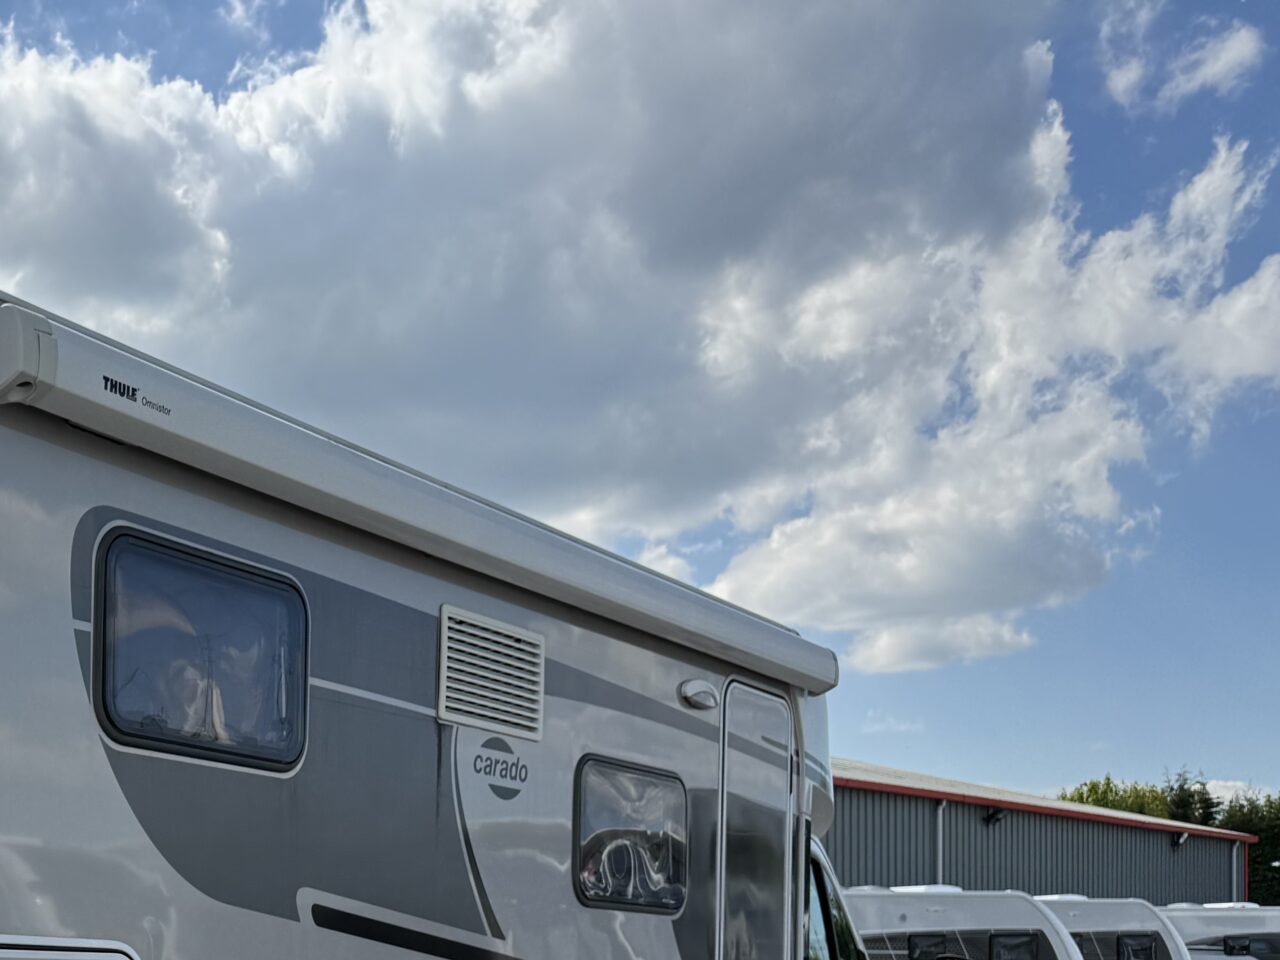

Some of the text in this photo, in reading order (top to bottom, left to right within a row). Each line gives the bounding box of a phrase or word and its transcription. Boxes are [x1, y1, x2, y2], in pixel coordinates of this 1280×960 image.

[102, 375, 172, 416] THULE Omnistor
[473, 754, 528, 783] carado
